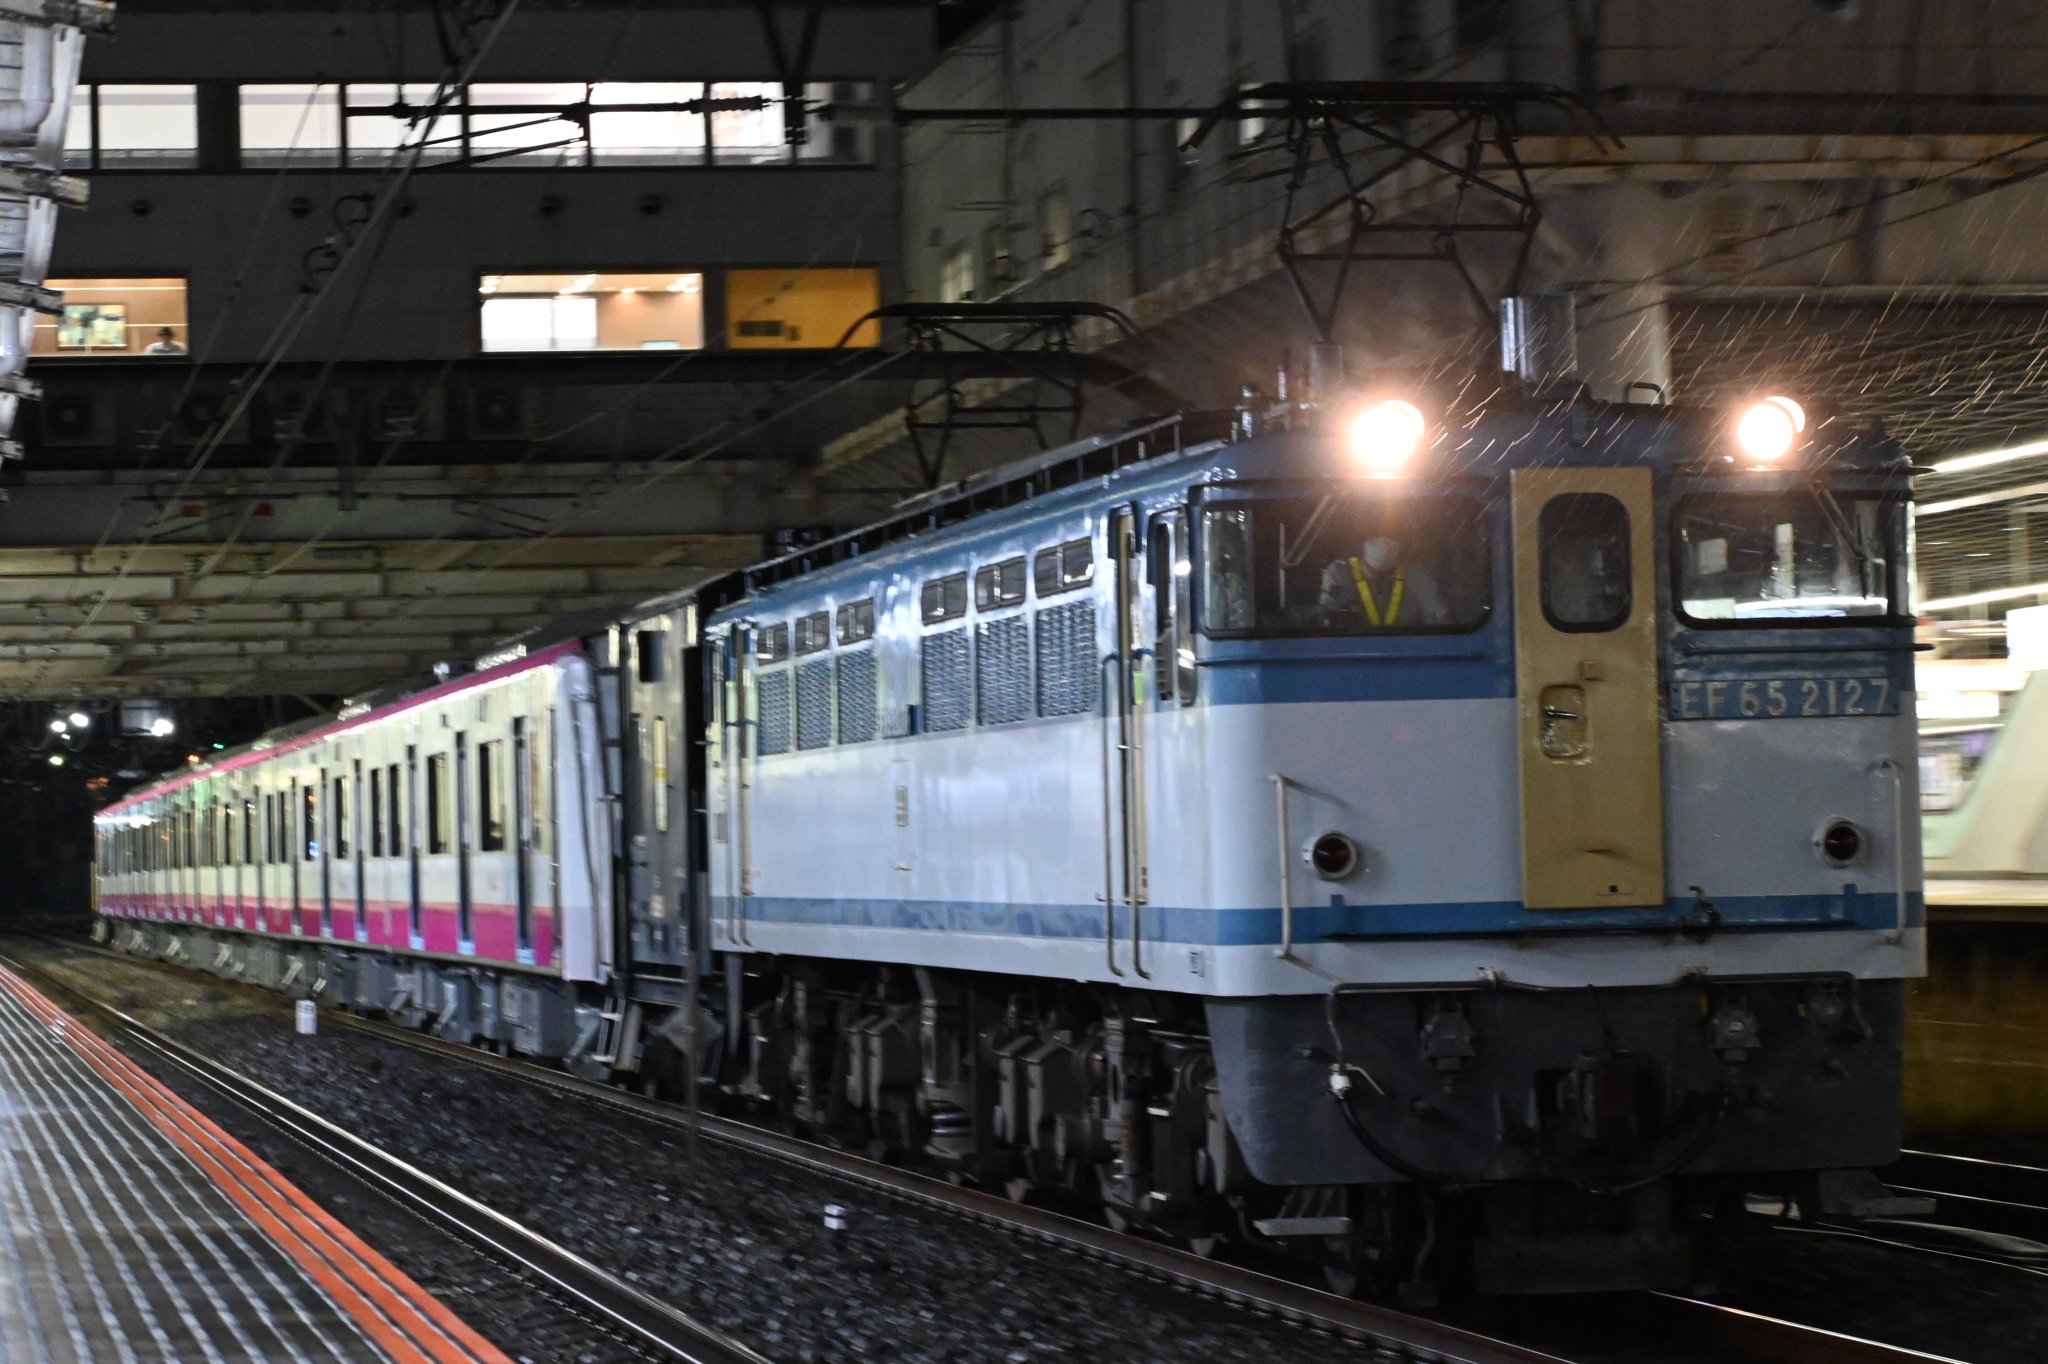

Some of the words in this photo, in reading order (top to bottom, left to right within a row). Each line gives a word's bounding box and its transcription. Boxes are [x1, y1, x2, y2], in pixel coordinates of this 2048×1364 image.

[1679, 682, 1729, 718] EF
[1739, 680, 1788, 716] 65
[1801, 678, 1890, 716] 2127
